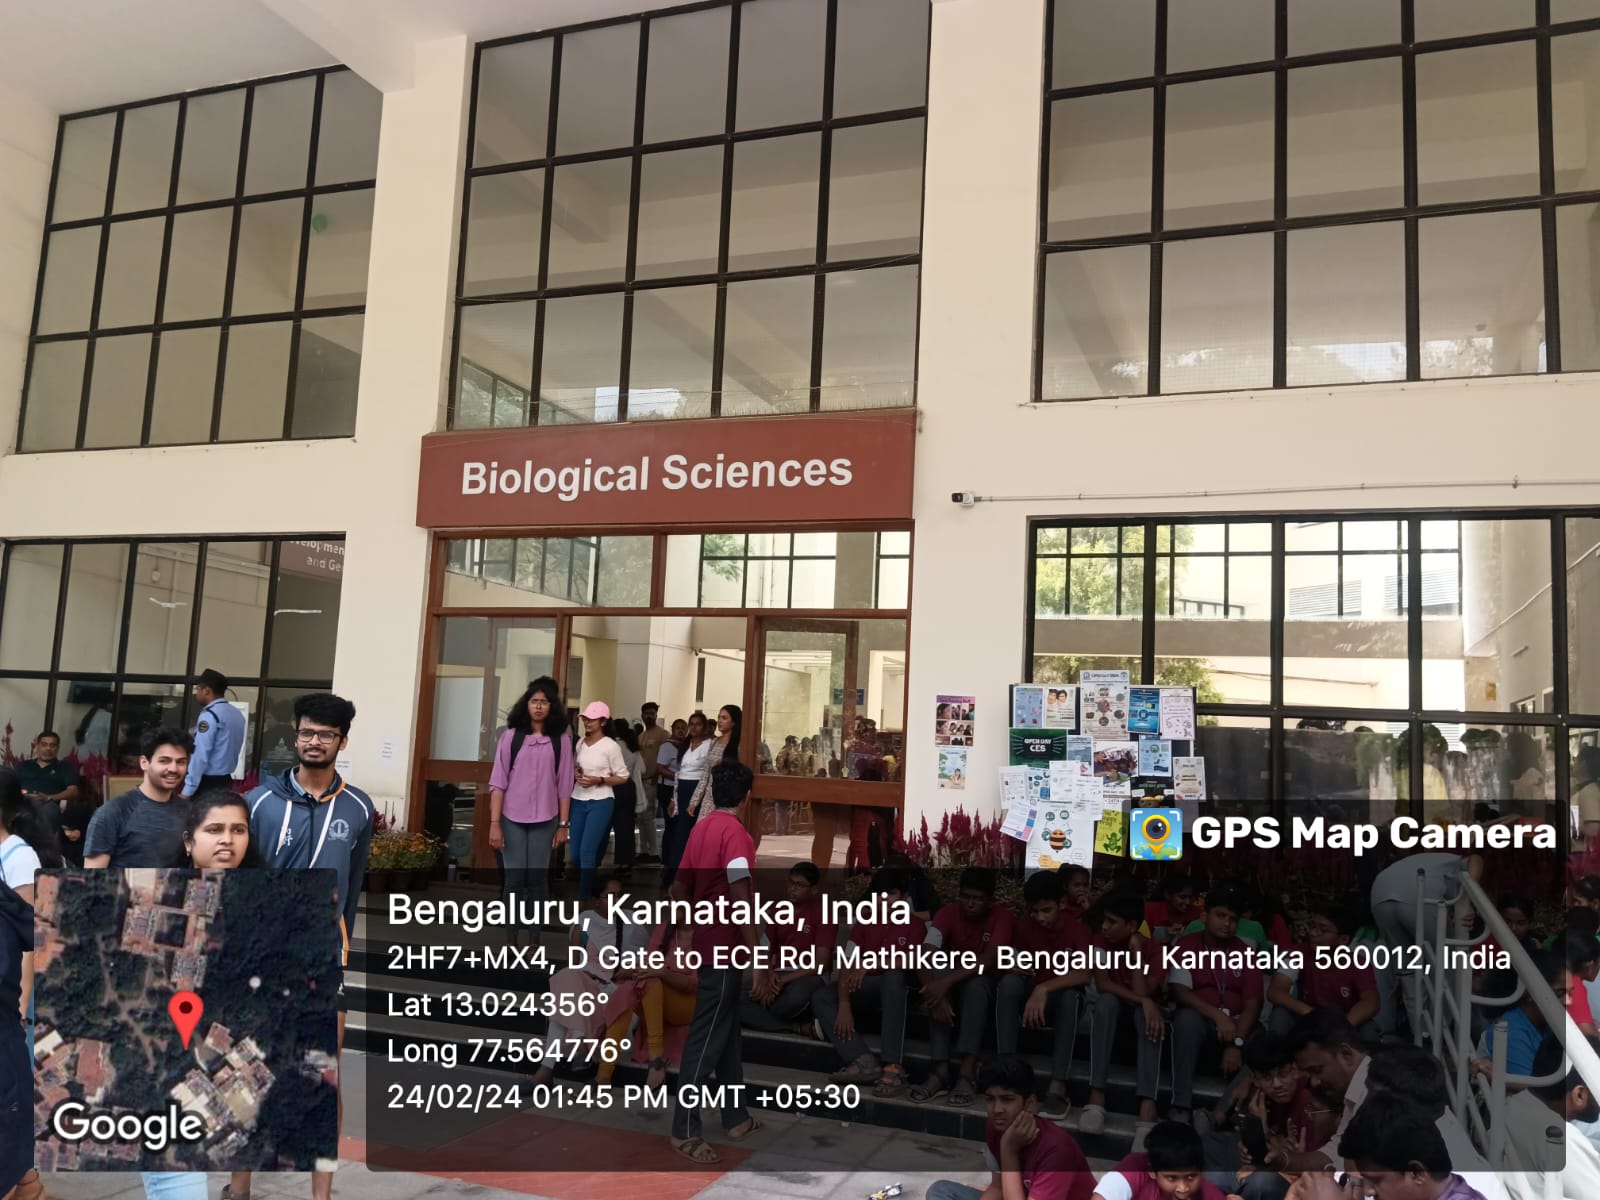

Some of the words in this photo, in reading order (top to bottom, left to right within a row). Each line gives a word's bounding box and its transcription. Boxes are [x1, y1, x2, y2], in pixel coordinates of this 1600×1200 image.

[462, 455, 649, 502] Biological
[662, 453, 853, 490] Sciences
[1029, 744, 1047, 752] CES
